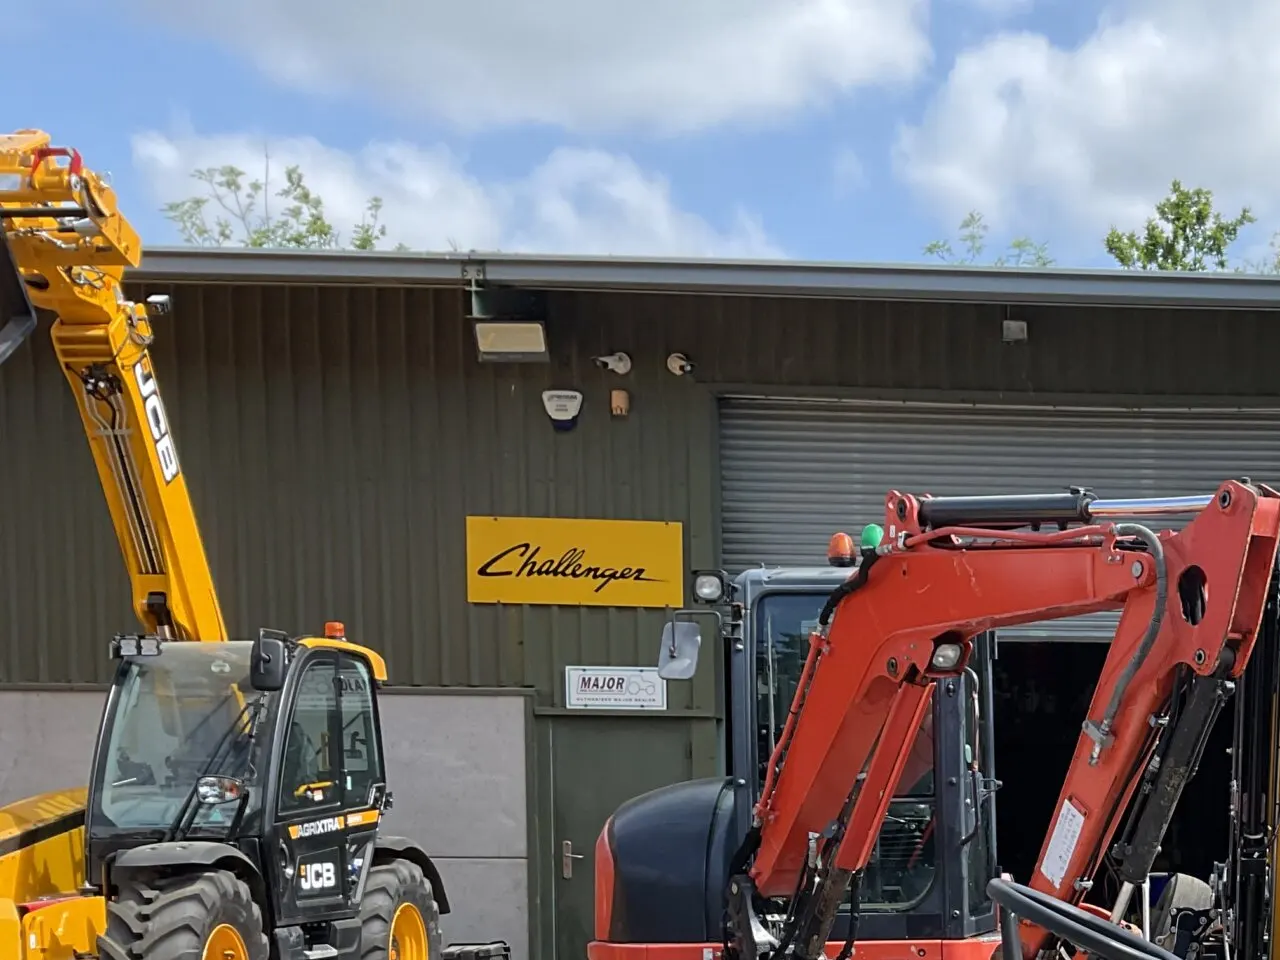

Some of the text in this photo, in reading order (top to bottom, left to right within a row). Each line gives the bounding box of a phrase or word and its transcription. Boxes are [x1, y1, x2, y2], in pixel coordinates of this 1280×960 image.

[134, 360, 178, 482] JCB
[477, 542, 671, 593] Challenger
[580, 677, 625, 690] MAJOR
[297, 817, 341, 838] AGRIXTRA
[301, 862, 336, 890] JCB
